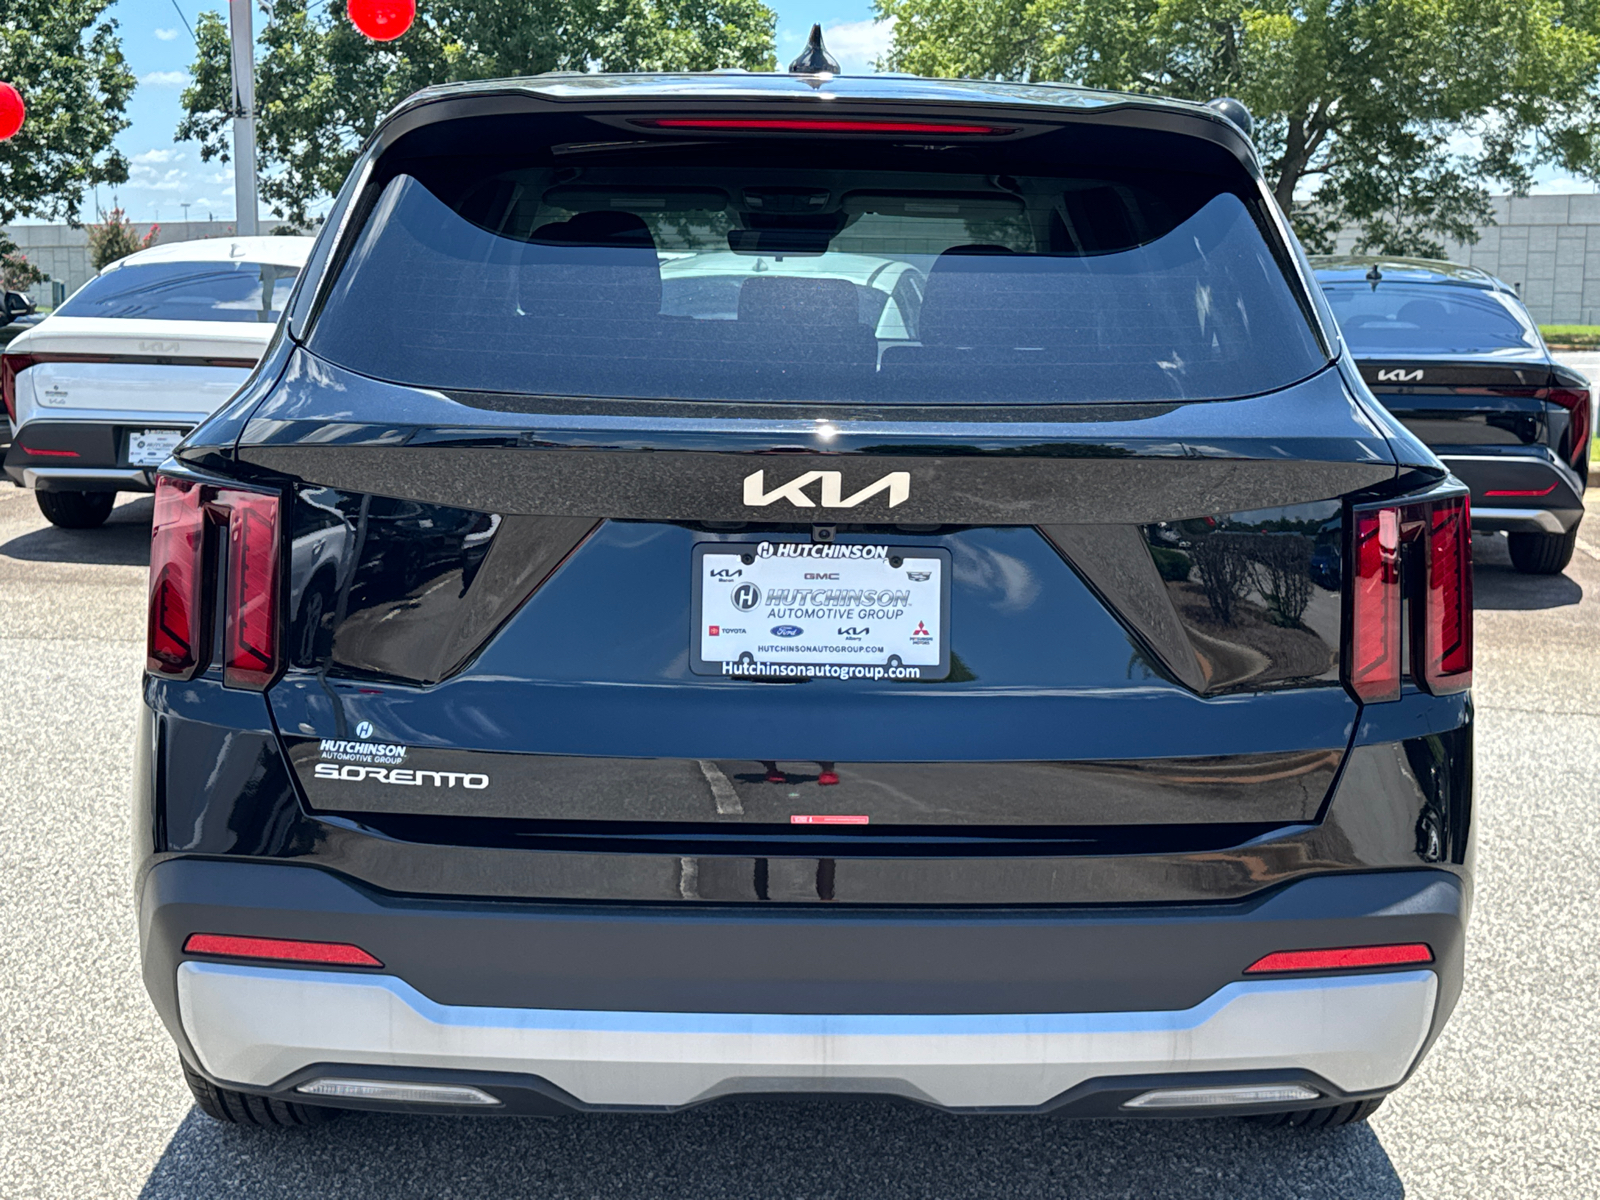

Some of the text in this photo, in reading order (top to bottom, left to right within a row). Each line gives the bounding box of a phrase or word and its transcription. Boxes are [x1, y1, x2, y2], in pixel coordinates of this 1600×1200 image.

[777, 543, 888, 560] HUTCHINSON
[765, 588, 910, 608] HUTCHINSON
[767, 608, 904, 620] AUTOMOTIVE GROUP
[776, 627, 797, 636] Ford
[758, 645, 884, 653] HUTCHINSONAUTOGROUP.COM
[722, 661, 920, 680] Hutchinsonautogroup.com
[320, 739, 407, 758] HUTCHINSON
[321, 751, 402, 764] AUTOMOTIVE GROUP
[314, 763, 490, 790] SORENTO
